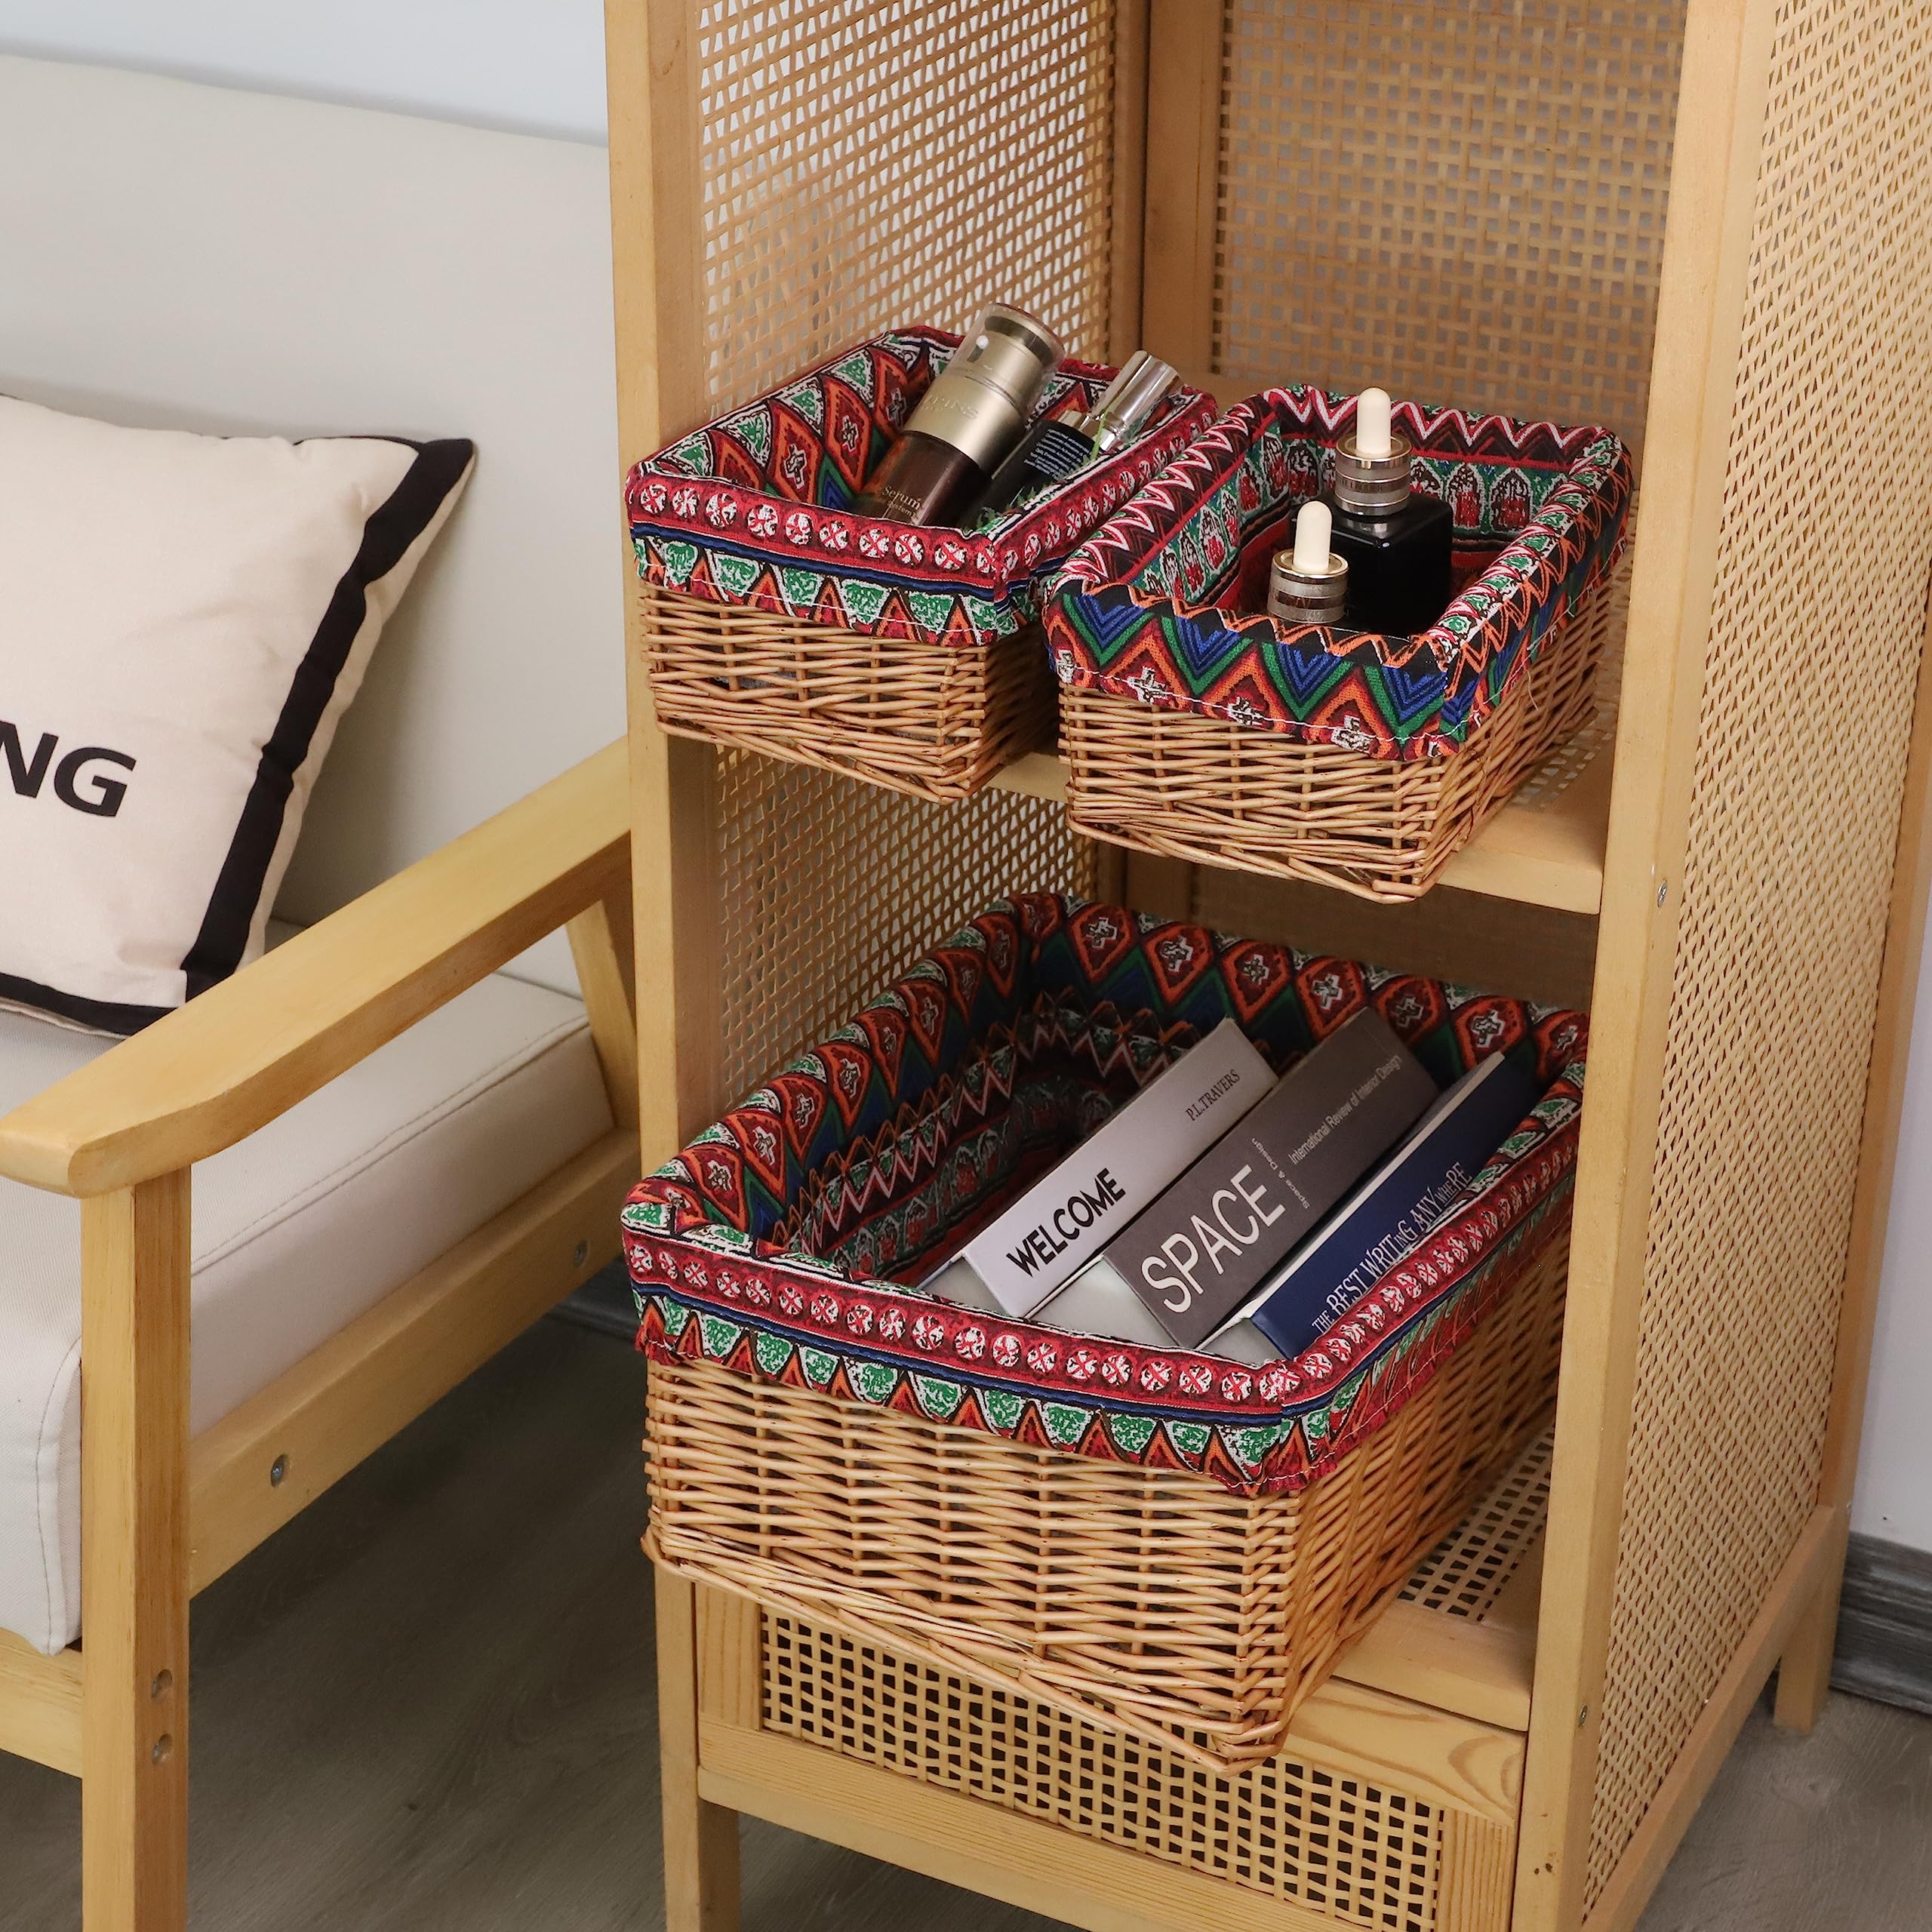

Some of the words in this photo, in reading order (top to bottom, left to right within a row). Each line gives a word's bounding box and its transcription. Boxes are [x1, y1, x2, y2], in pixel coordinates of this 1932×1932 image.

[881, 484, 921, 510] Serum
[1186, 1069, 1240, 1121] P.L.TRAVERS
[1287, 1122, 1331, 1164] International
[1325, 1100, 1353, 1128] Review
[1349, 1092, 1360, 1106] of
[1355, 1075, 1381, 1100] Interior
[1375, 1055, 1402, 1080] Design
[1251, 1137, 1278, 1171] Design
[1278, 1171, 1286, 1179] &
[1285, 1179, 1310, 1209] Space
[1005, 1168, 1127, 1278] WELCOME
[1141, 1164, 1287, 1314] SPACE
[1312, 1309, 1335, 1334] THE
[1326, 1268, 1369, 1315] BEST
[1359, 1220, 1419, 1279] WRITING
